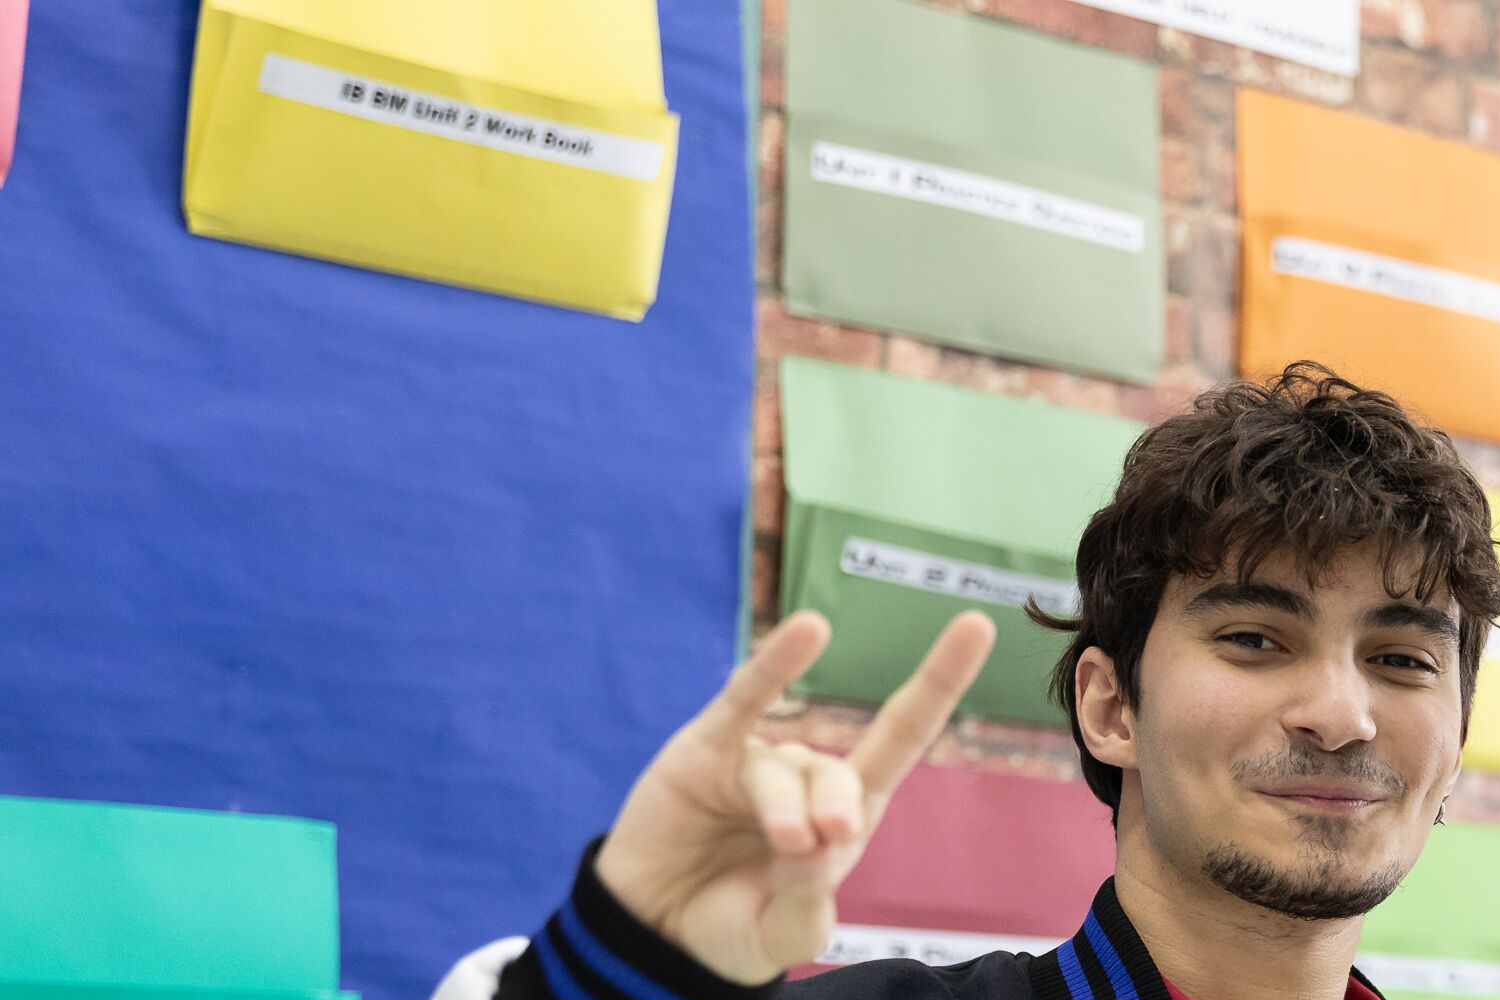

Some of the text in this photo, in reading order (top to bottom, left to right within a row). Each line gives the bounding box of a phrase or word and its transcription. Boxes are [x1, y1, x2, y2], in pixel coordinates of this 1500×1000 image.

[373, 89, 408, 113] BM
[416, 99, 457, 124] Unit
[464, 112, 477, 131] 2
[486, 117, 537, 145] Work
[543, 130, 594, 157] Book
